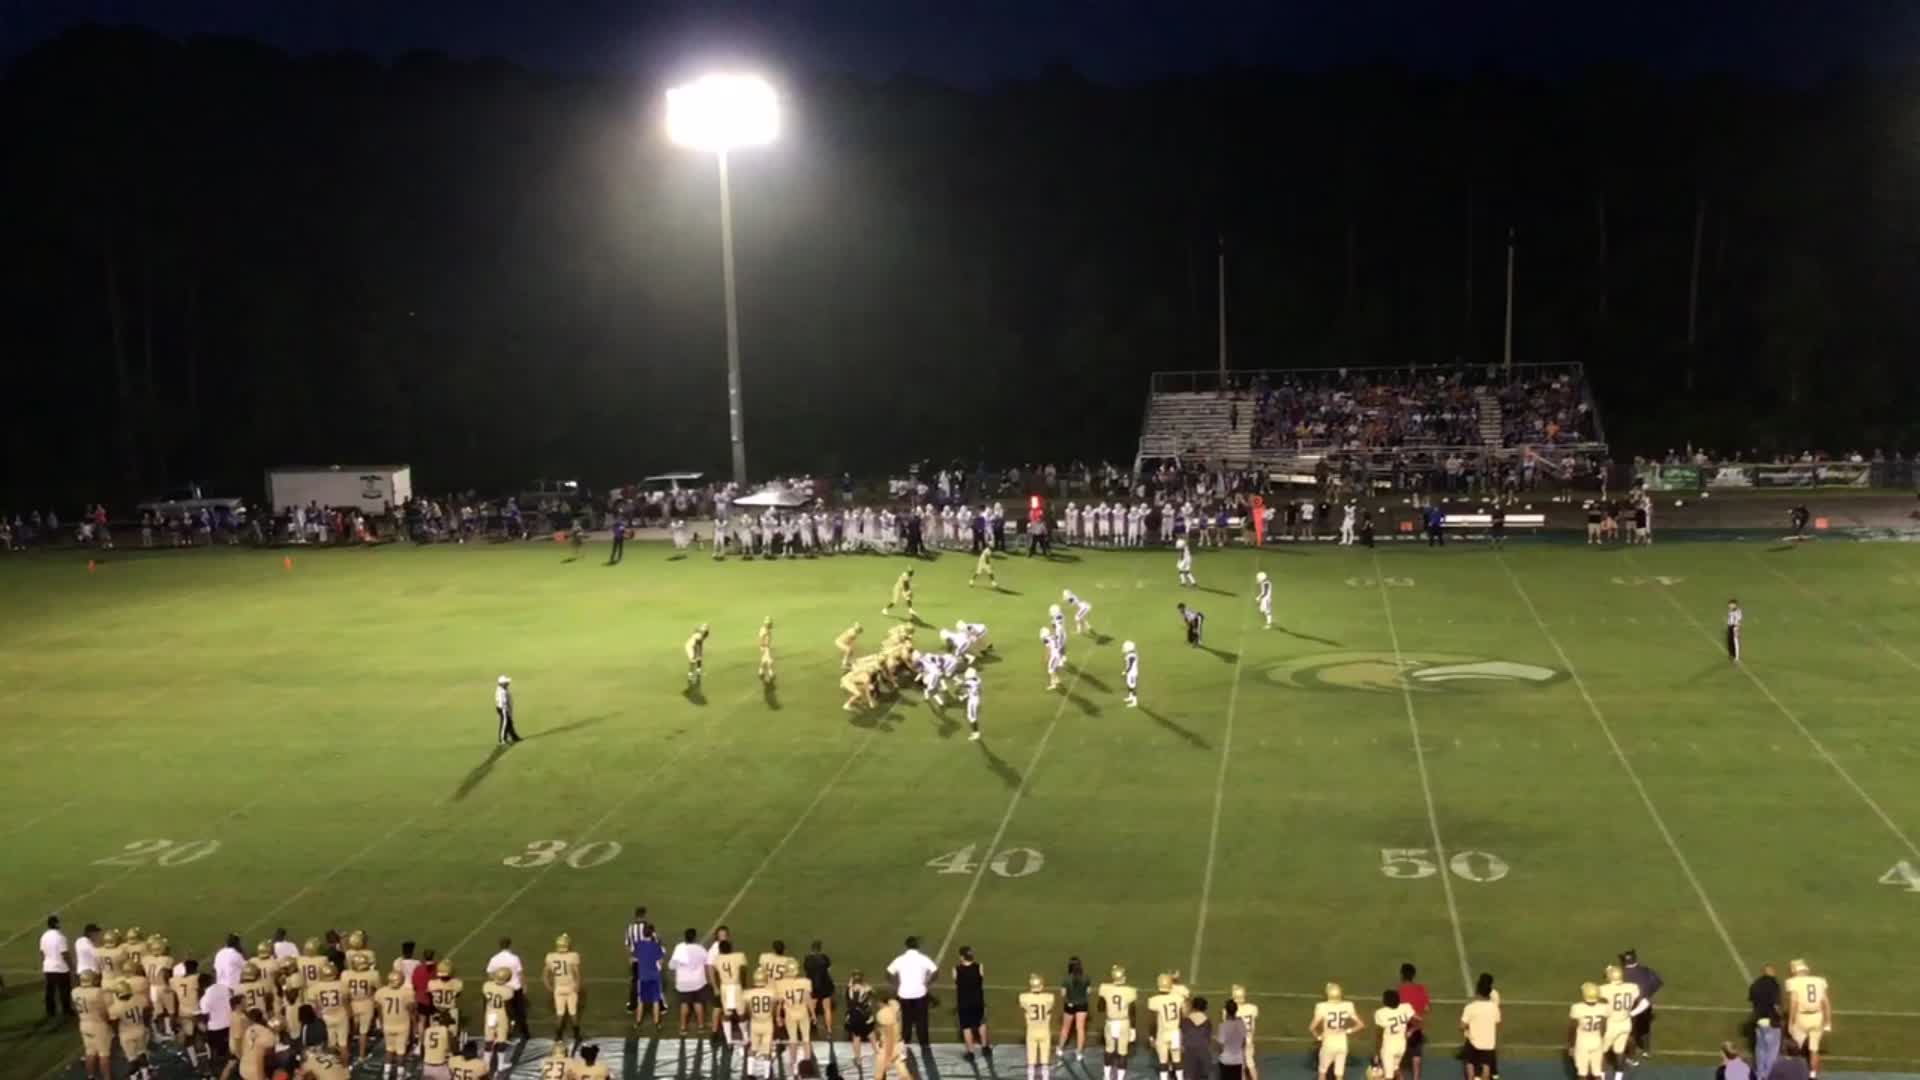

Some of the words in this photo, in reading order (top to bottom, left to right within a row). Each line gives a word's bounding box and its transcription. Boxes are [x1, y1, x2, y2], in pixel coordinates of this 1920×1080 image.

[89, 839, 222, 867] 20
[503, 840, 622, 869] 30
[925, 841, 1045, 878] 40
[1381, 848, 1509, 882] 50
[553, 960, 569, 976] 21
[722, 962, 732, 976] 4
[766, 964, 786, 981] 45
[246, 987, 265, 1006] 34
[785, 989, 805, 1005] 47
[1613, 993, 1633, 1011] 60
[1806, 984, 1817, 1003] 8
[385, 997, 400, 1015] 71
[751, 995, 771, 1014] 88
[1029, 1003, 1046, 1022] 31
[1111, 995, 1123, 1012] 9
[1163, 1003, 1179, 1021] 13
[1327, 1012, 1347, 1030] 26
[1388, 1014, 1408, 1035] 24
[430, 1032, 439, 1049] 5
[544, 1061, 565, 1079] 23
